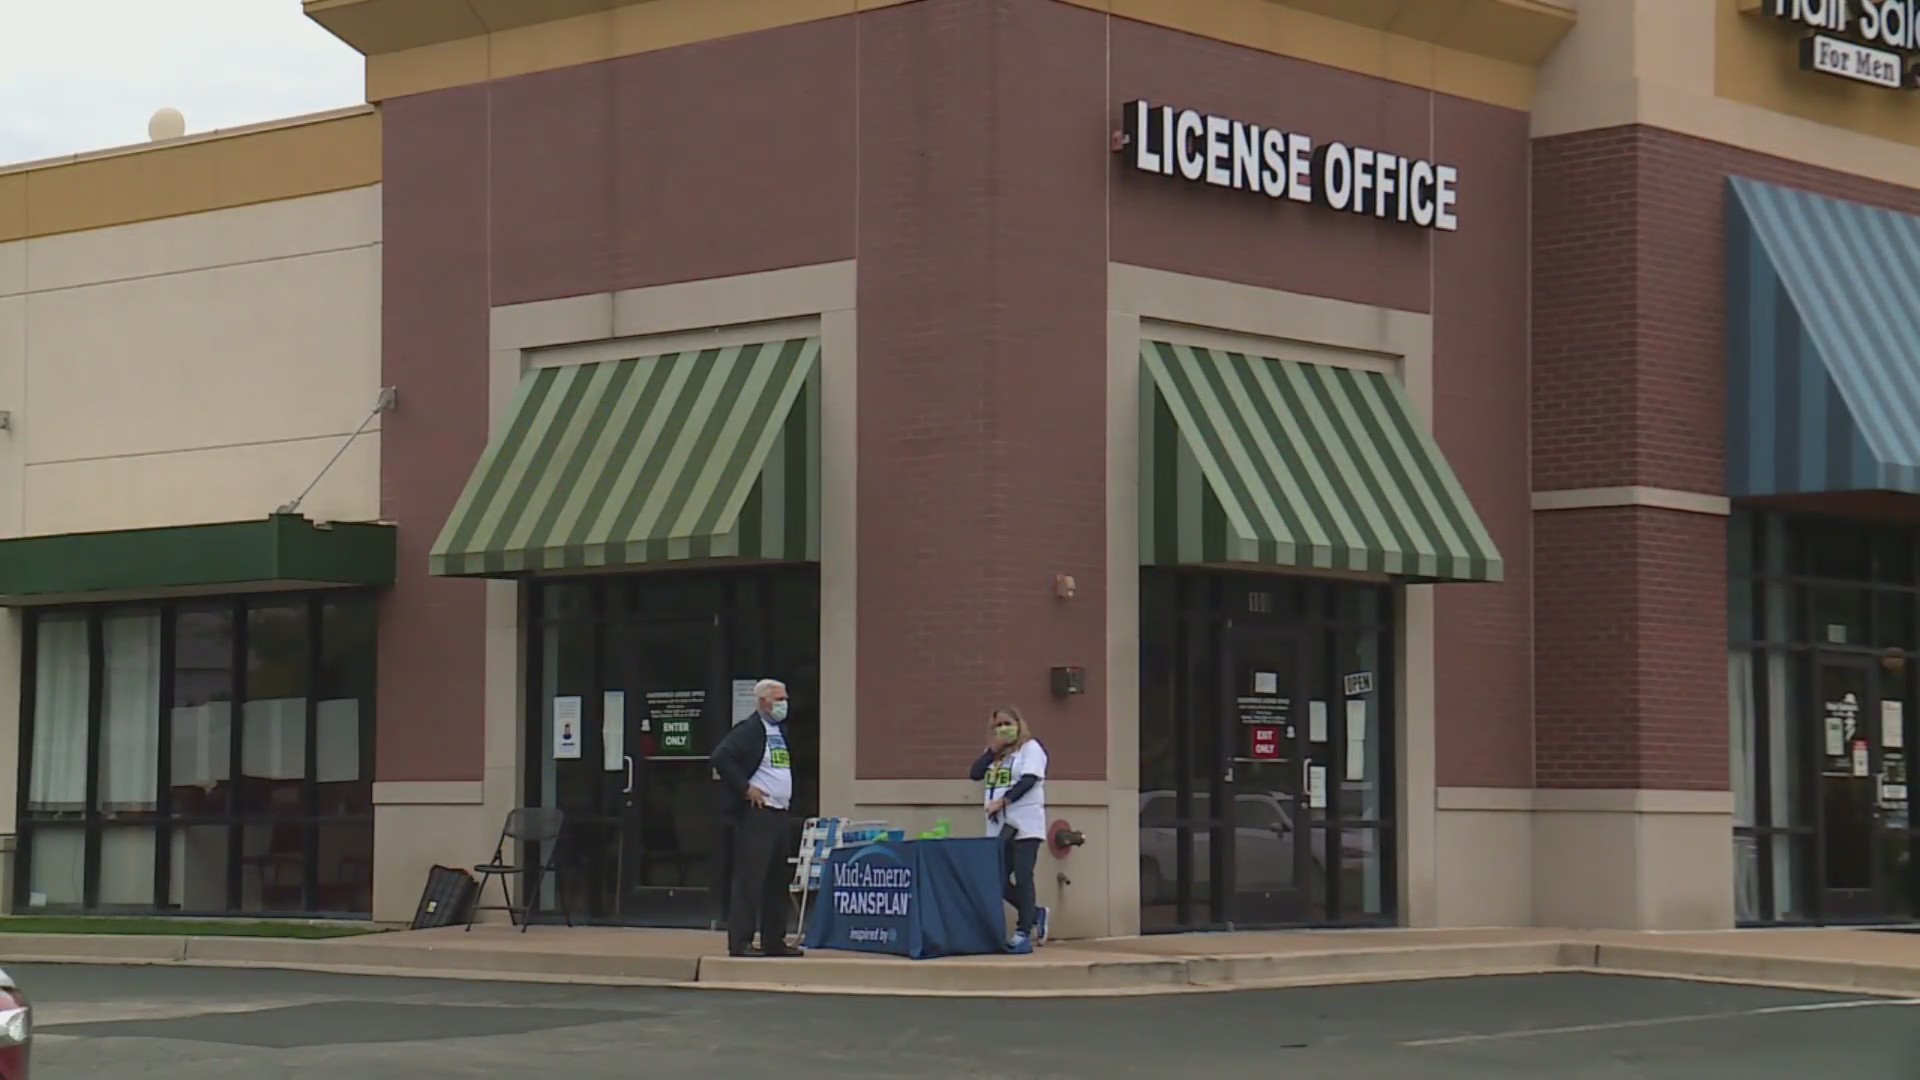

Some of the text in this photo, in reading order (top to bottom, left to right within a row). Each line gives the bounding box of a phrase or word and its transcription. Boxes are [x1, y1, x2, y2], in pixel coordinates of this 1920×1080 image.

[1775, 0, 1846, 32] ar
[1819, 41, 1896, 82] For Men
[1136, 99, 1458, 231] LICENSE OFFICE
[1347, 675, 1370, 692] OPEN
[662, 722, 689, 733] ENTER
[1256, 730, 1274, 741] EXIT
[665, 735, 687, 746] ONLY
[1255, 743, 1275, 754] ONLY
[986, 770, 1009, 786] LE
[833, 891, 909, 915] TRANSPLAN
[849, 926, 879, 942] inspired
[880, 927, 888, 944] by
